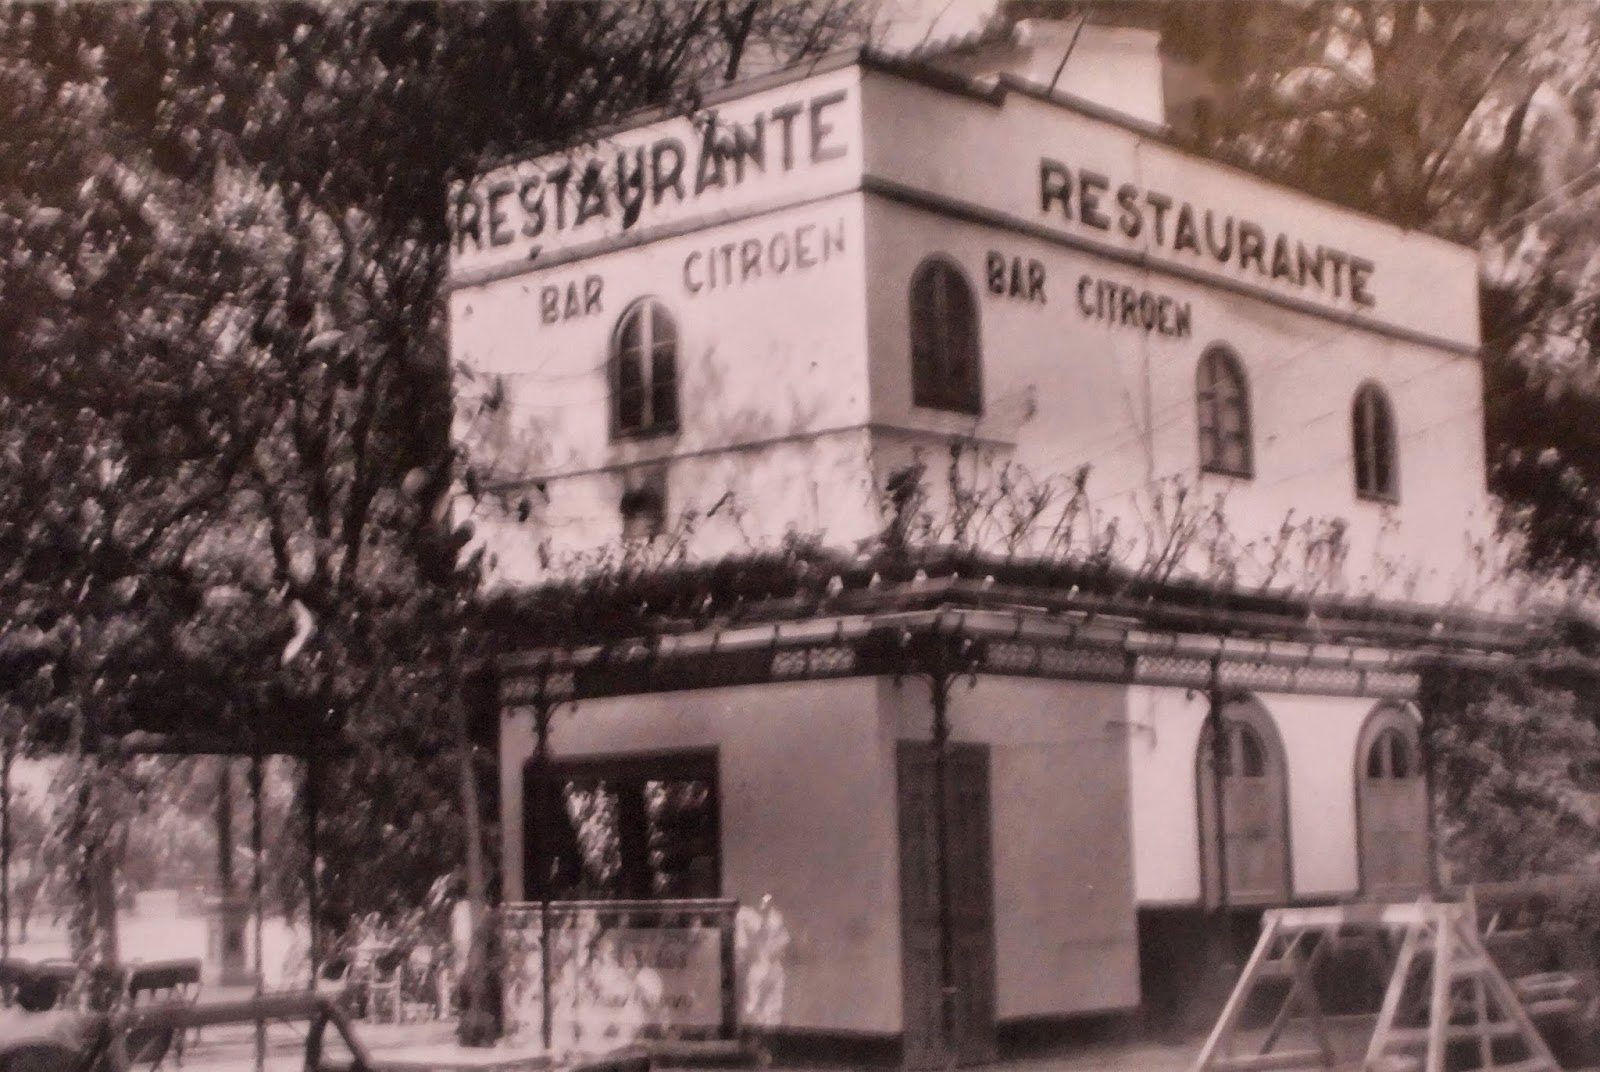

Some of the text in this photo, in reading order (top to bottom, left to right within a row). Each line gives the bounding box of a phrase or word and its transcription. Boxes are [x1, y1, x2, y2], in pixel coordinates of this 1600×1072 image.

[454, 89, 848, 254] RESTAURANTE
[1040, 157, 1376, 308] RESTAURANTE
[540, 217, 846, 325] BAR CITROEN
[986, 250, 1192, 337] BAR CITROEN
